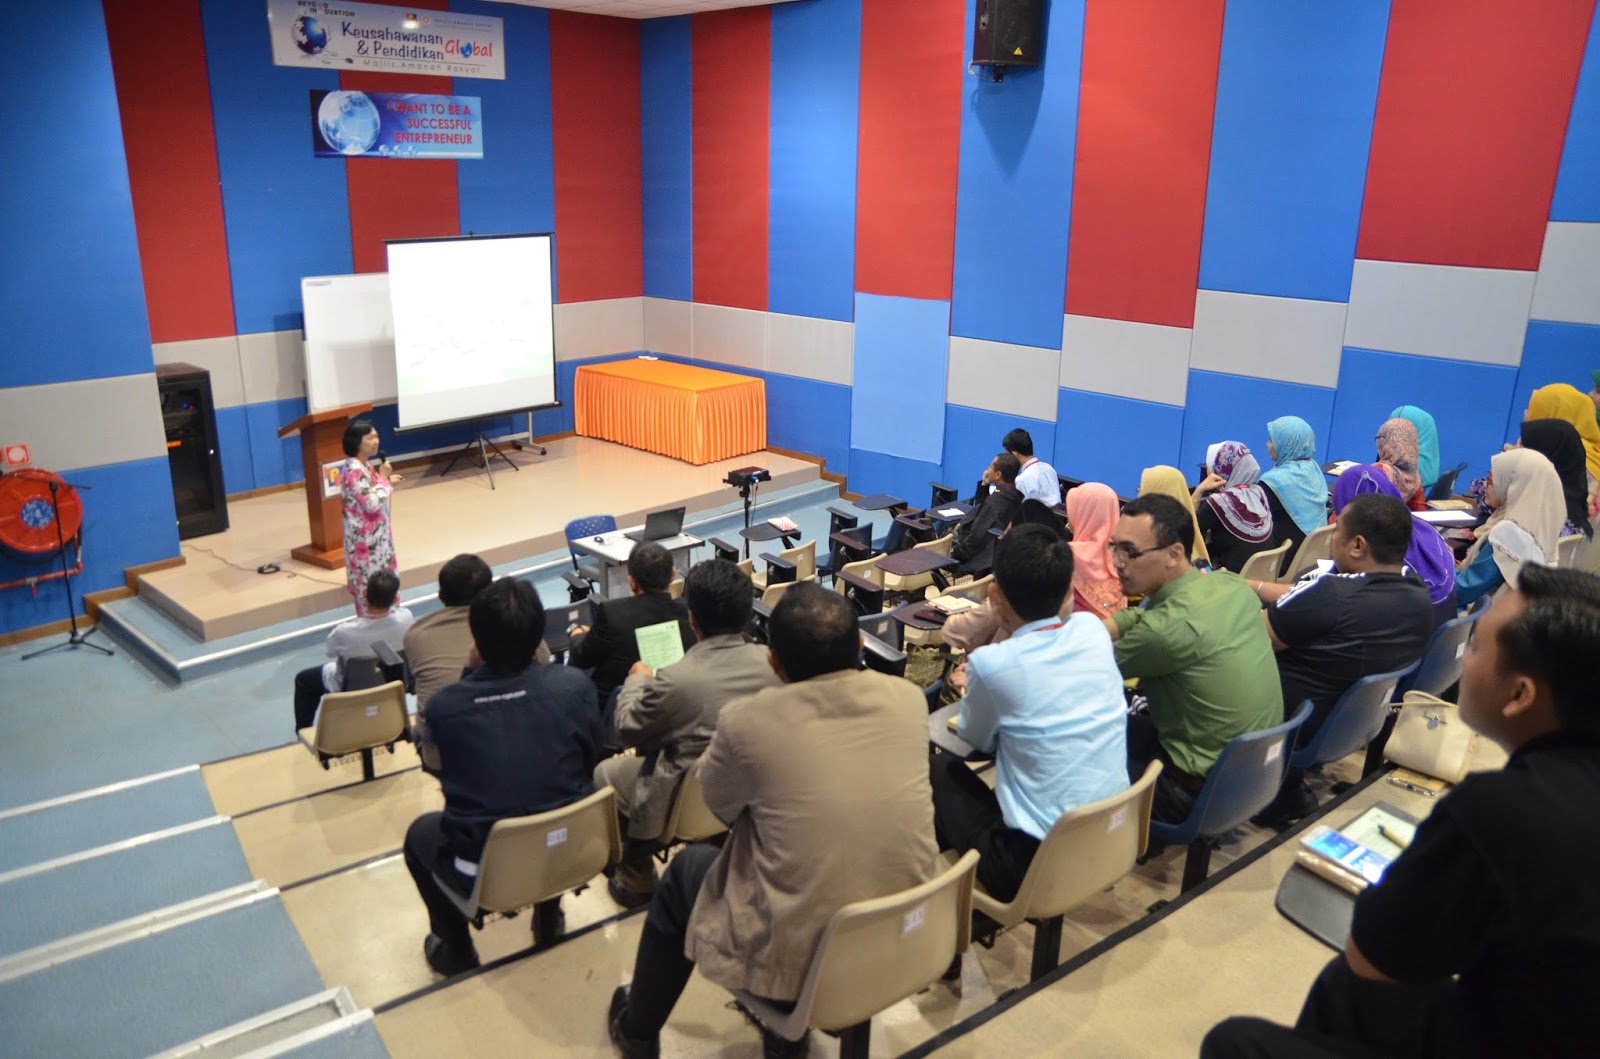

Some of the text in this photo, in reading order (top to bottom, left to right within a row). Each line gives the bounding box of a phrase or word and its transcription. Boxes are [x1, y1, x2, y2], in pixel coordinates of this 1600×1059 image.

[341, 21, 443, 45] Keusahawanan
[356, 40, 444, 60] & Pendidikan
[444, 39, 493, 59] Global
[401, 61, 442, 71] Amanah
[446, 64, 480, 74] Rakyat
[396, 102, 427, 115] WANT
[430, 103, 445, 115] TO
[448, 103, 460, 115] BE
[463, 105, 472, 116] A
[406, 118, 473, 131] SUCCESSFUL
[394, 132, 473, 145] ENTREPRENEUR
